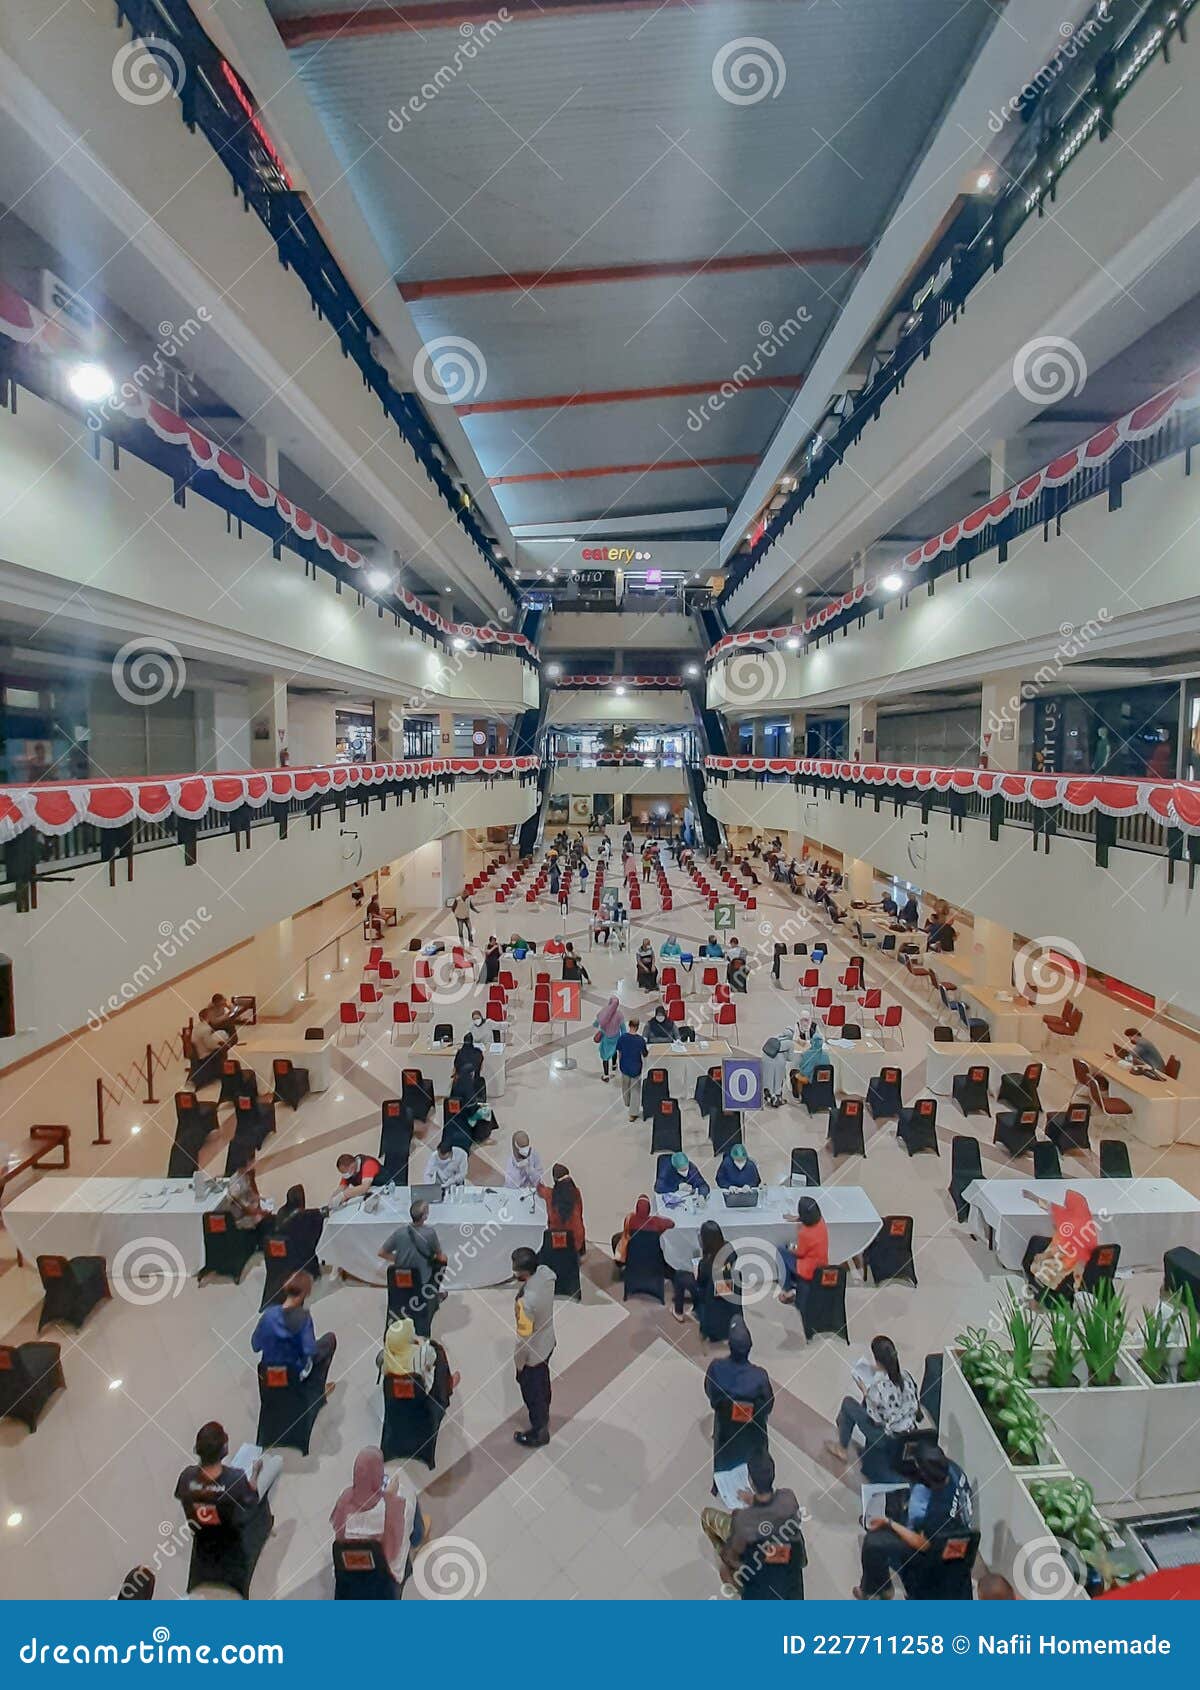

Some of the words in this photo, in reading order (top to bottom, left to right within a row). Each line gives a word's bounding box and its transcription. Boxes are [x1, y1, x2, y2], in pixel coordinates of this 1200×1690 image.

[582, 544, 635, 564] eatery
[719, 907, 732, 926] 2
[556, 987, 571, 1013] 1
